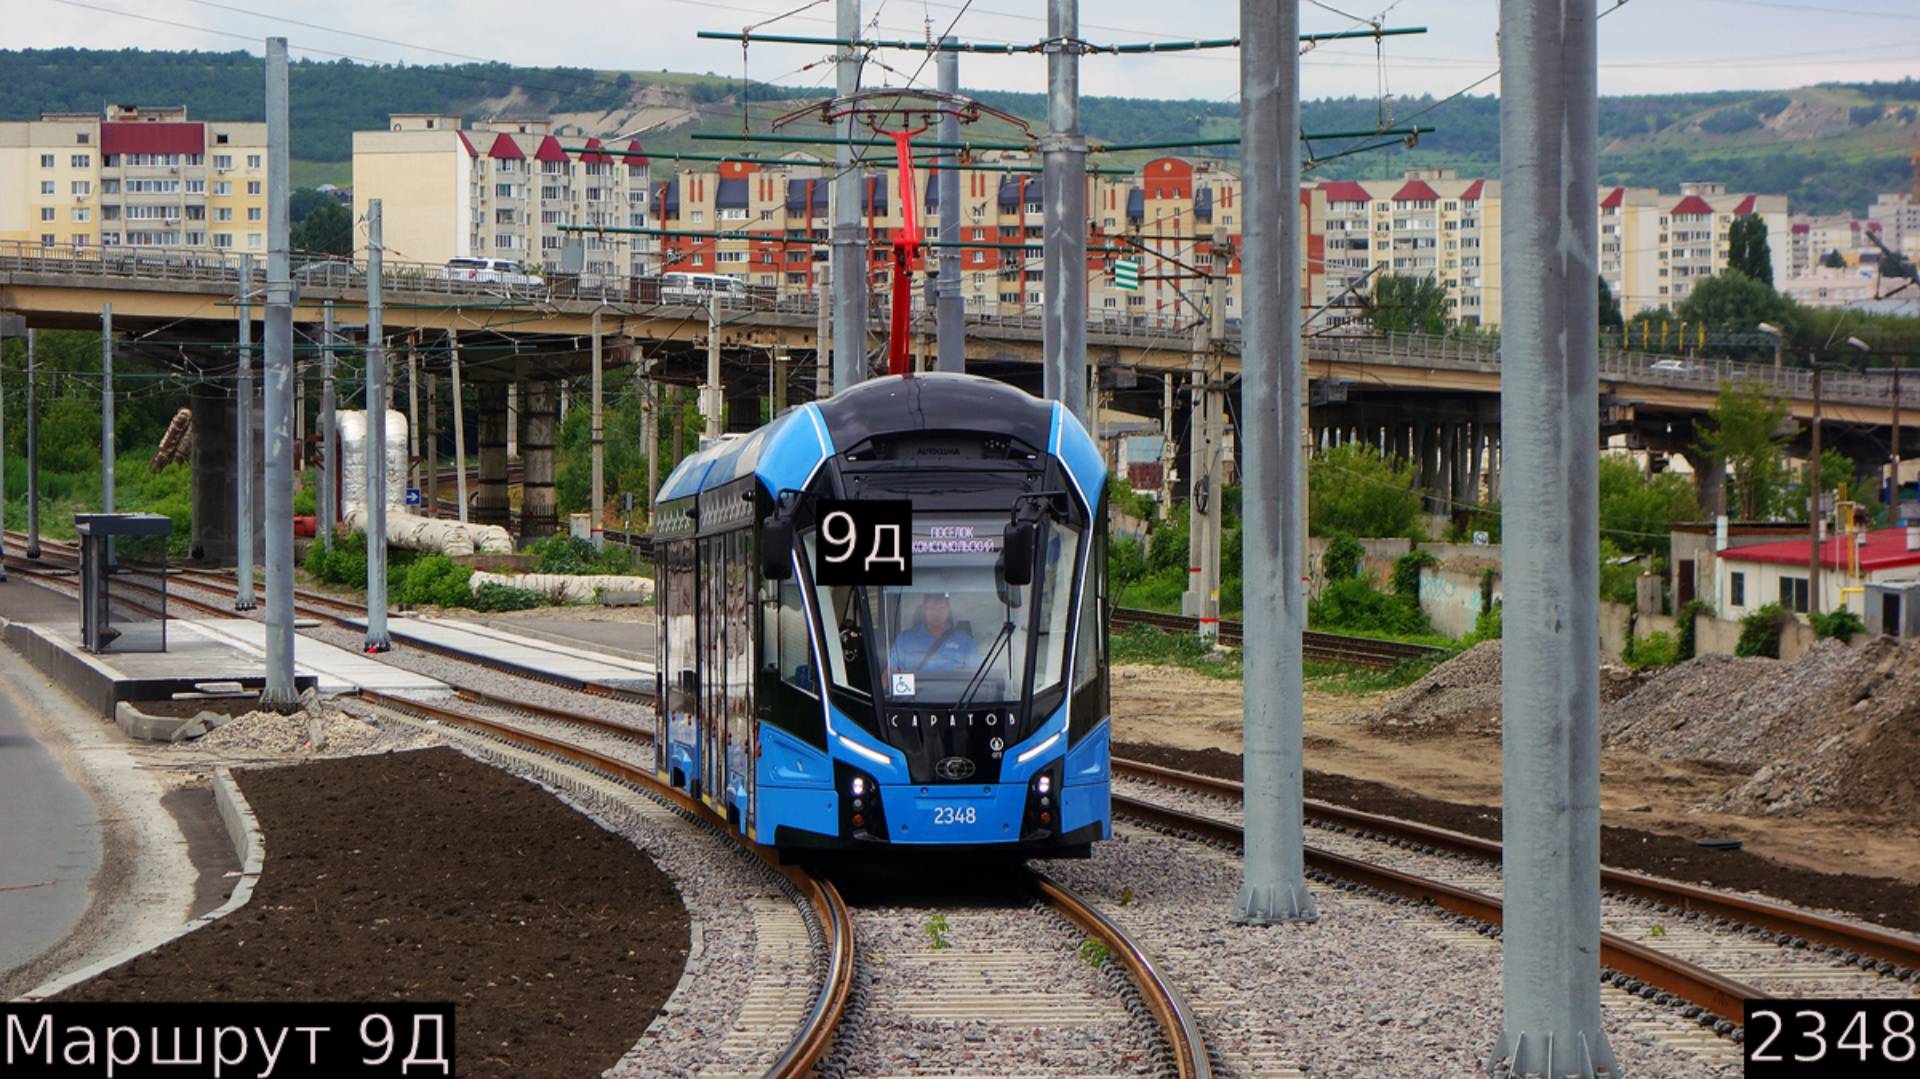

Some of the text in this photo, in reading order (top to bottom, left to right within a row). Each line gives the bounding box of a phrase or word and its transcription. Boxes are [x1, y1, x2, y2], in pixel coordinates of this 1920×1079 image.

[930, 526, 974, 539] ПОСЕЛОК
[891, 713, 1015, 728] САРАТОВ
[934, 807, 976, 825] 2348
